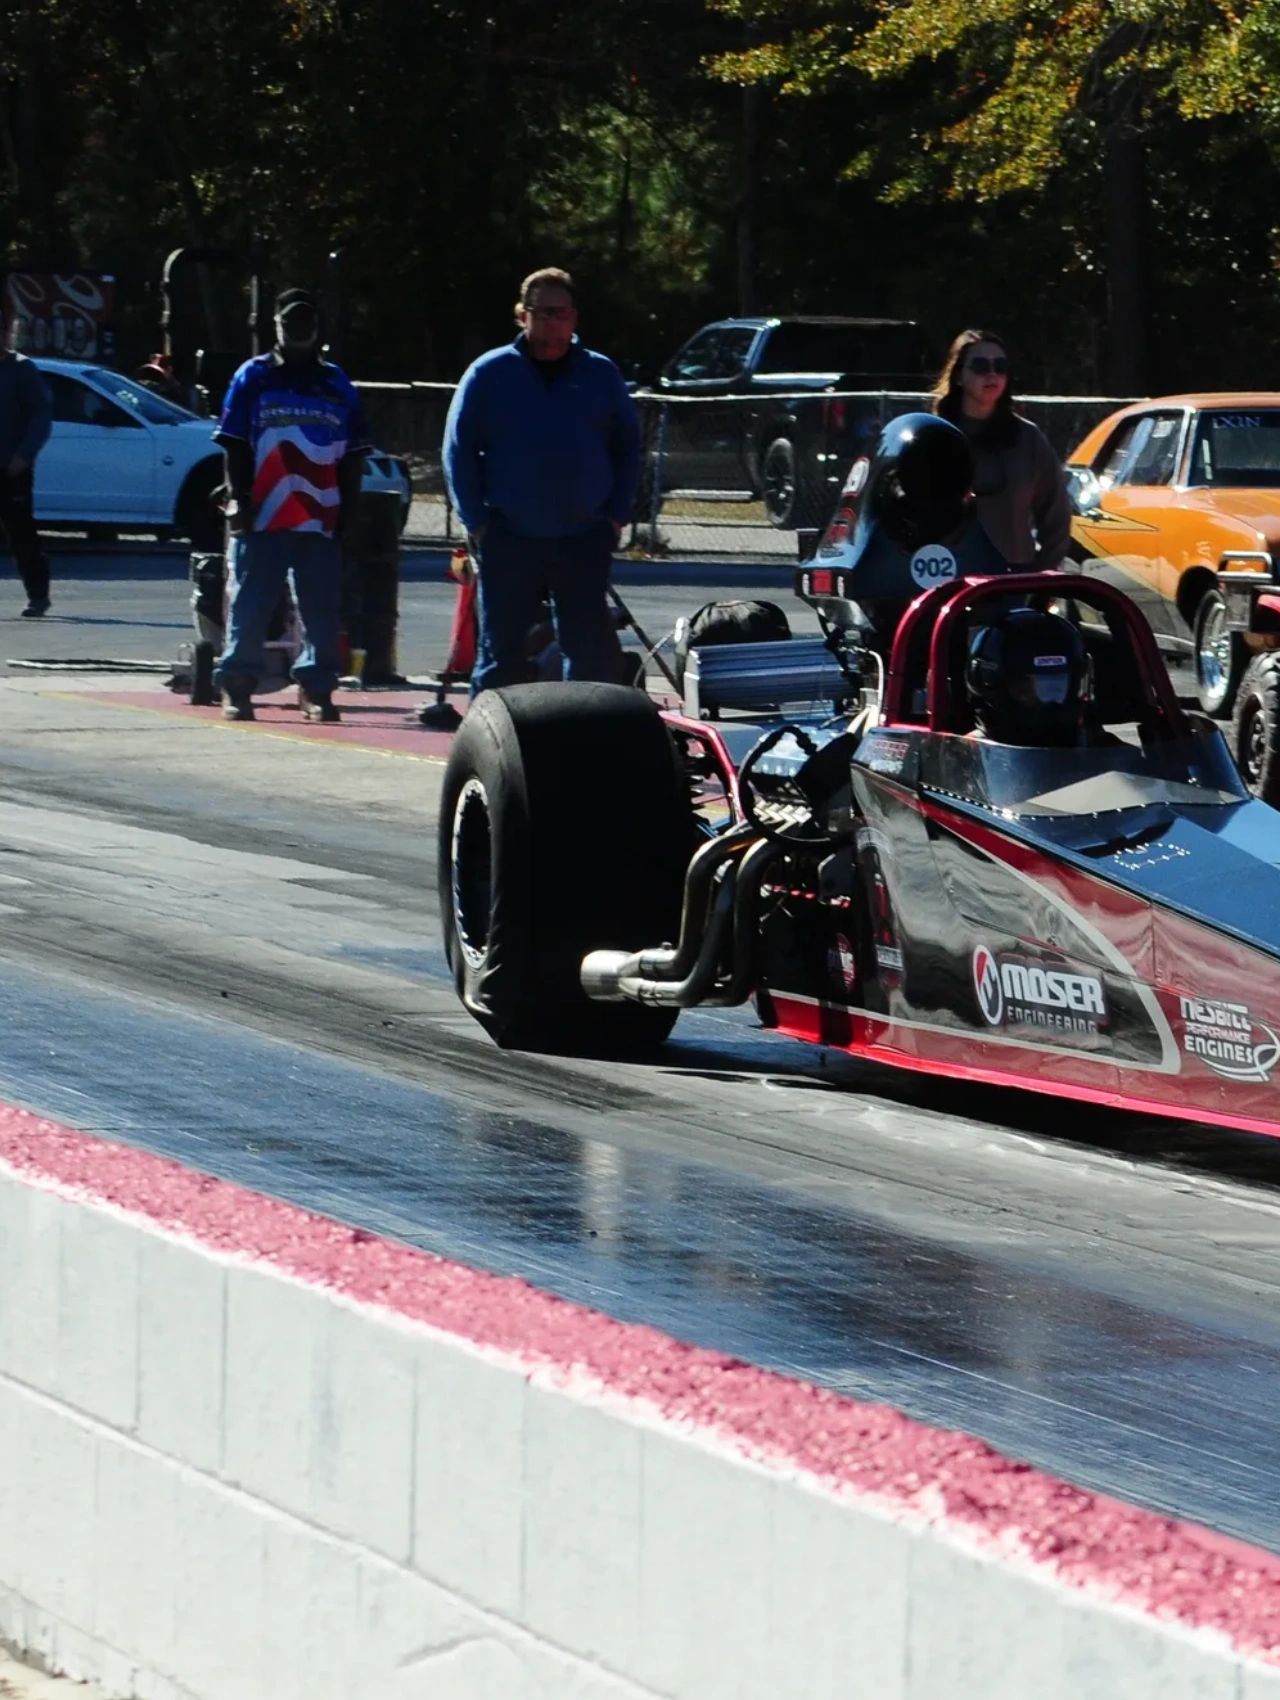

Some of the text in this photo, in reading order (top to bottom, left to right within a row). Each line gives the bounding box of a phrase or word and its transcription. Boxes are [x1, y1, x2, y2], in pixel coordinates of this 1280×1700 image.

[914, 557, 953, 578] 902
[1000, 962, 1106, 1015] MOSER
[1006, 1005, 1098, 1032] ENGINEERING
[1184, 1020, 1251, 1045] PERFORMANCE
[1184, 1034, 1254, 1064] ENGINES
